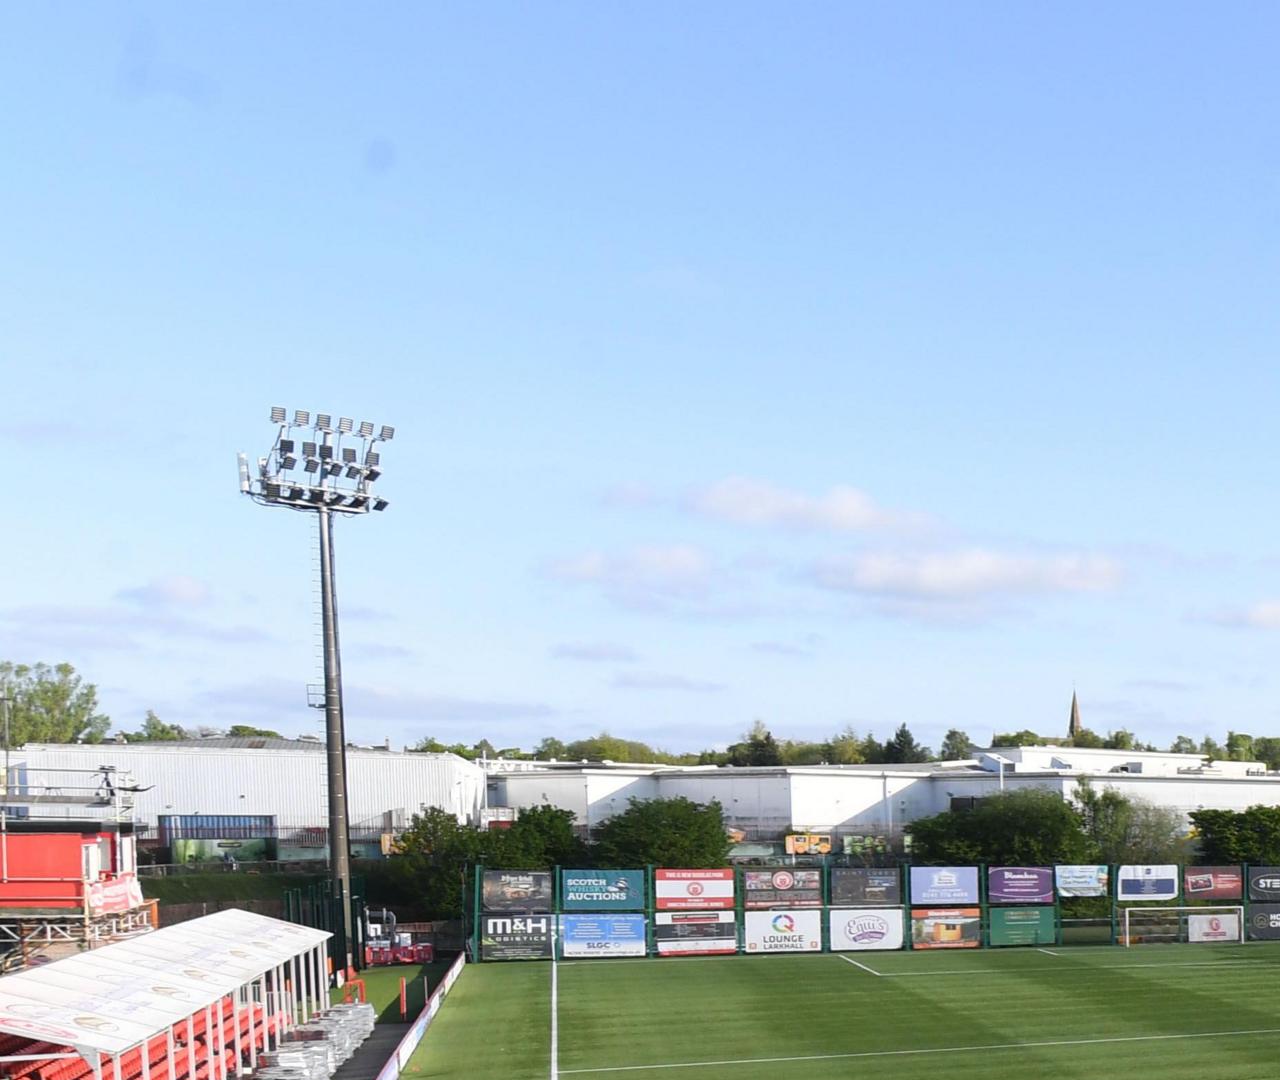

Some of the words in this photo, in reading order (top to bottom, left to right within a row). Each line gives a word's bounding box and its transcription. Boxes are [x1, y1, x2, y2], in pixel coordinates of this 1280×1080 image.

[567, 878, 607, 886] SCOTCH
[567, 892, 627, 900] AUCTIONS
[487, 918, 547, 934] M&H
[763, 934, 805, 943] LOUNGE
